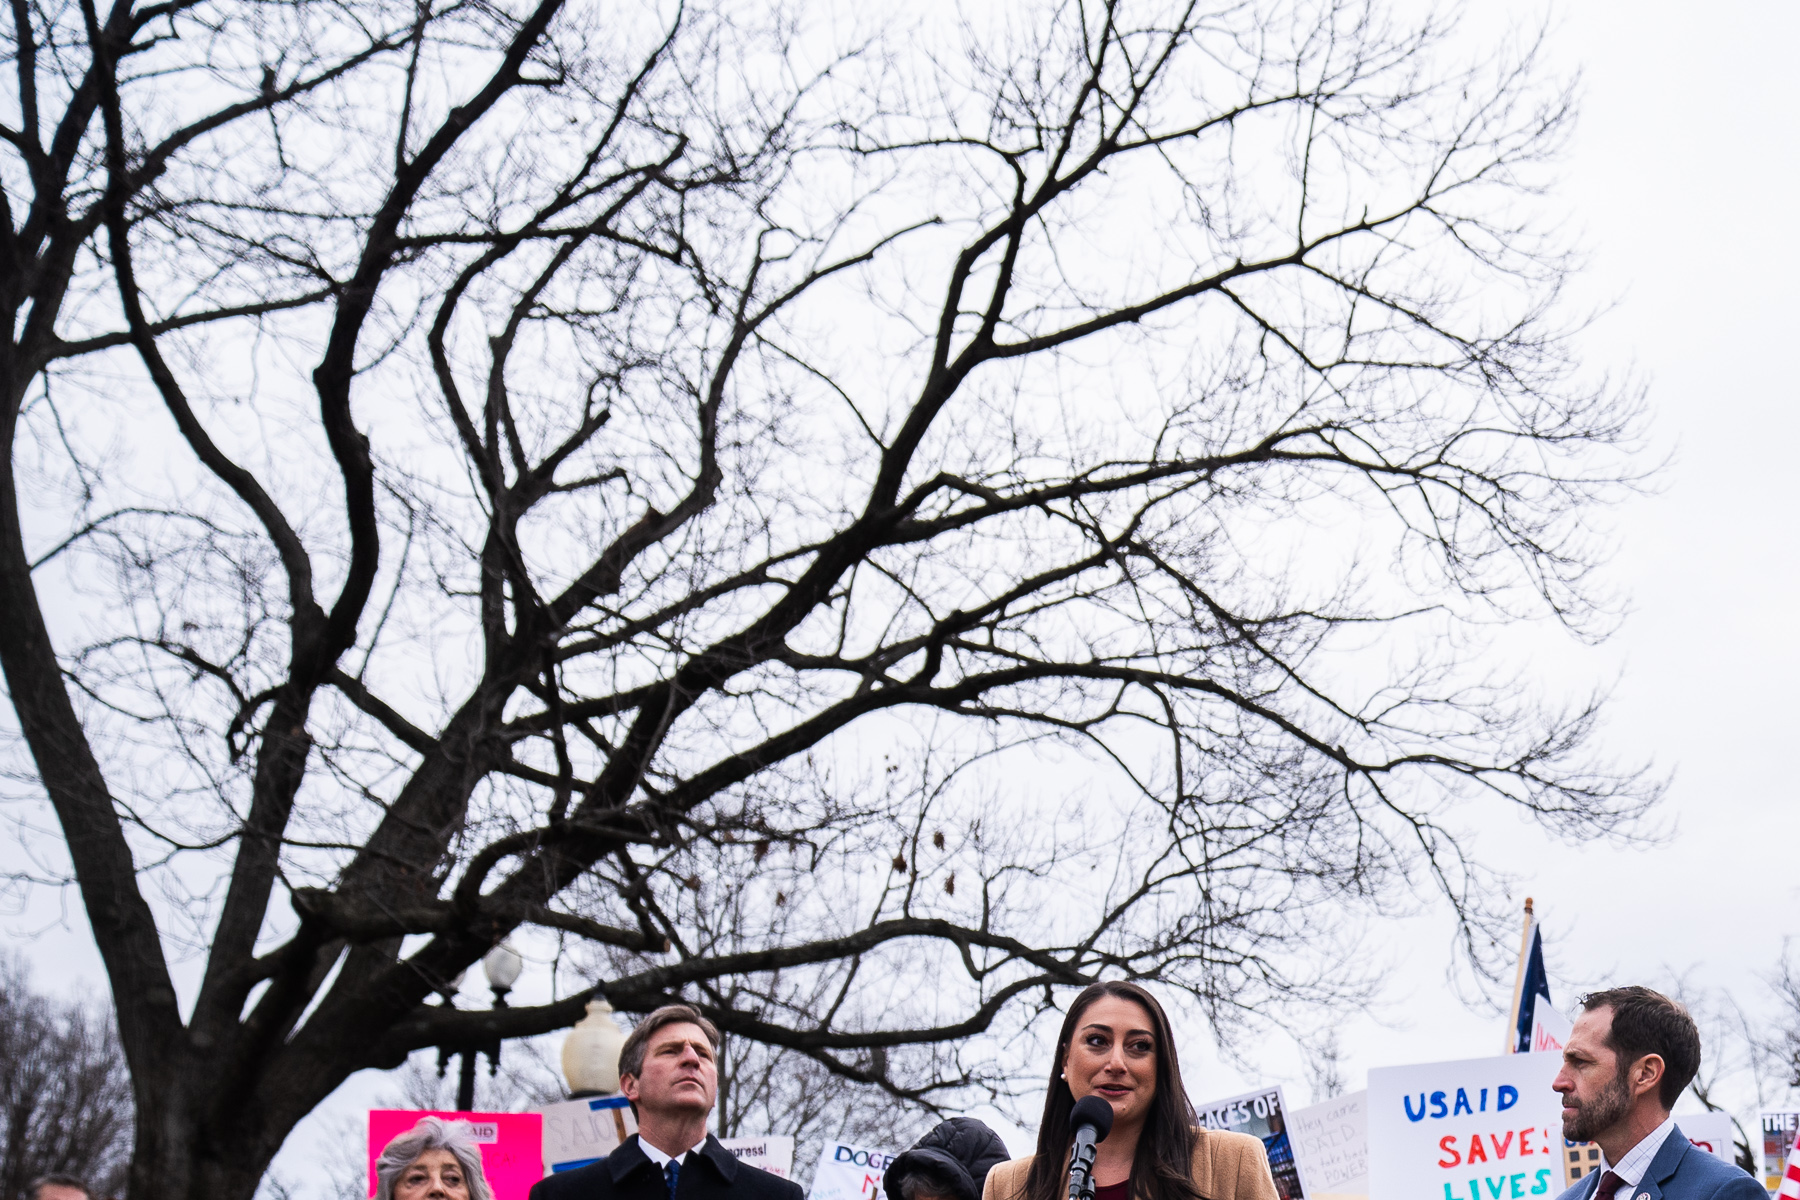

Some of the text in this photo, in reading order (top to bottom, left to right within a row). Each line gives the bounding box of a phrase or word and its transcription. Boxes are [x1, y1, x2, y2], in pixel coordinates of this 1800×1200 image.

[1254, 1093, 1280, 1119] OF
[1404, 1085, 1519, 1122] USAID
[472, 1126, 494, 1138] AID
[1762, 1114, 1797, 1132] THE
[727, 1142, 767, 1159] ngress!
